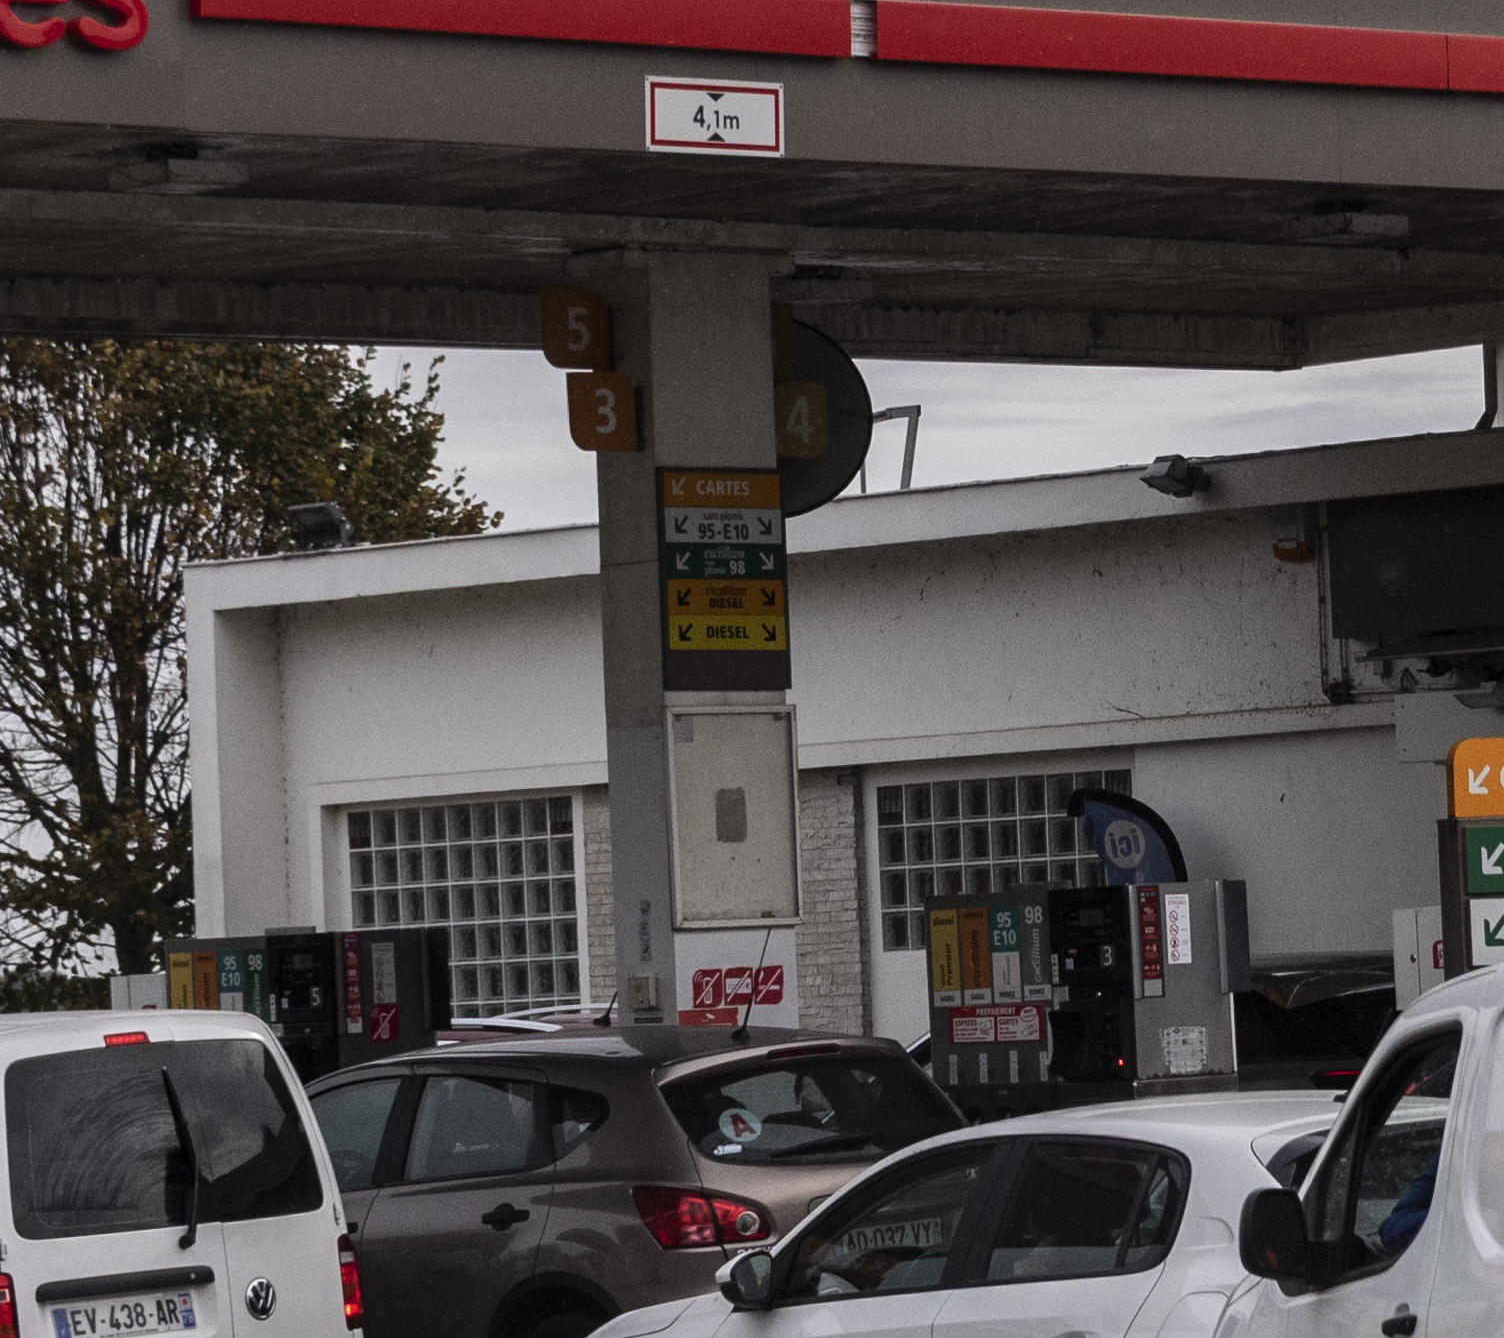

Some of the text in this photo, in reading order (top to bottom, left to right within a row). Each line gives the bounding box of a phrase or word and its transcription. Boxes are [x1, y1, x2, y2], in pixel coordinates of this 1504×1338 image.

[693, 105, 741, 132] 4,1m
[568, 306, 590, 352] 5
[594, 387, 617, 434] 3
[786, 395, 812, 444] 4
[696, 480, 750, 496] CARTES
[698, 523, 750, 540] 95-E10
[729, 560, 745, 575] 98
[709, 598, 745, 609] DIESEL
[706, 625, 750, 639] DIESEL
[996, 911, 1012, 928] 95
[1024, 905, 1043, 924] 98
[993, 929, 1017, 946] E10
[222, 955, 237, 971] 95
[247, 954, 263, 971] 98
[1102, 945, 1113, 966] 3
[221, 972, 241, 987] E10
[311, 987, 321, 1006] 5
[730, 1113, 757, 1138] A
[70, 1298, 180, 1336] EV-438-AR
